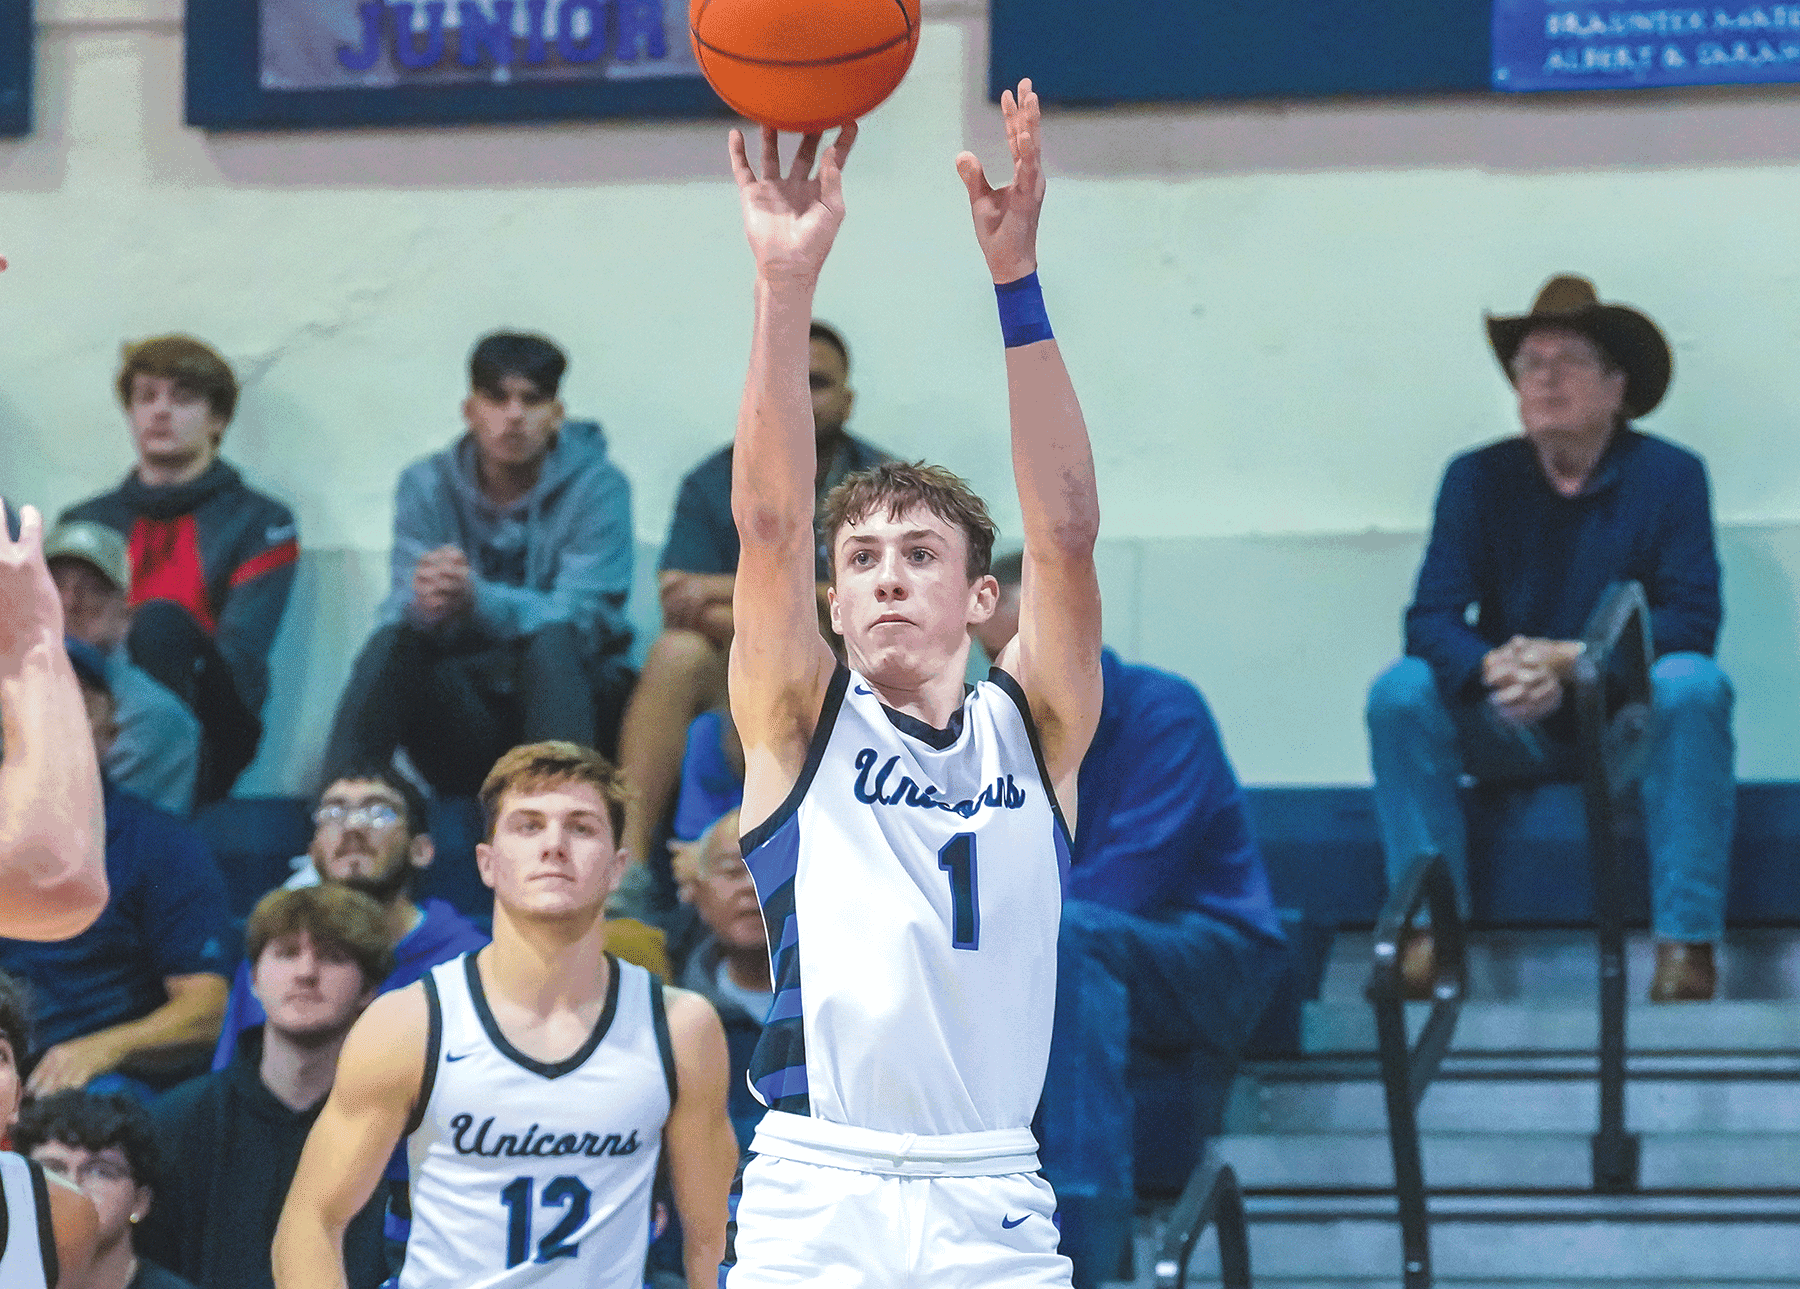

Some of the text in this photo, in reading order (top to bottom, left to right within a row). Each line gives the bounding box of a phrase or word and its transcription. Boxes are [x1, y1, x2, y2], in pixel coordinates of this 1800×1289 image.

[336, 0, 668, 70] JUNIOR
[937, 831, 981, 951] 1
[450, 1111, 641, 1157] Unicorns
[499, 1174, 593, 1270] 12
